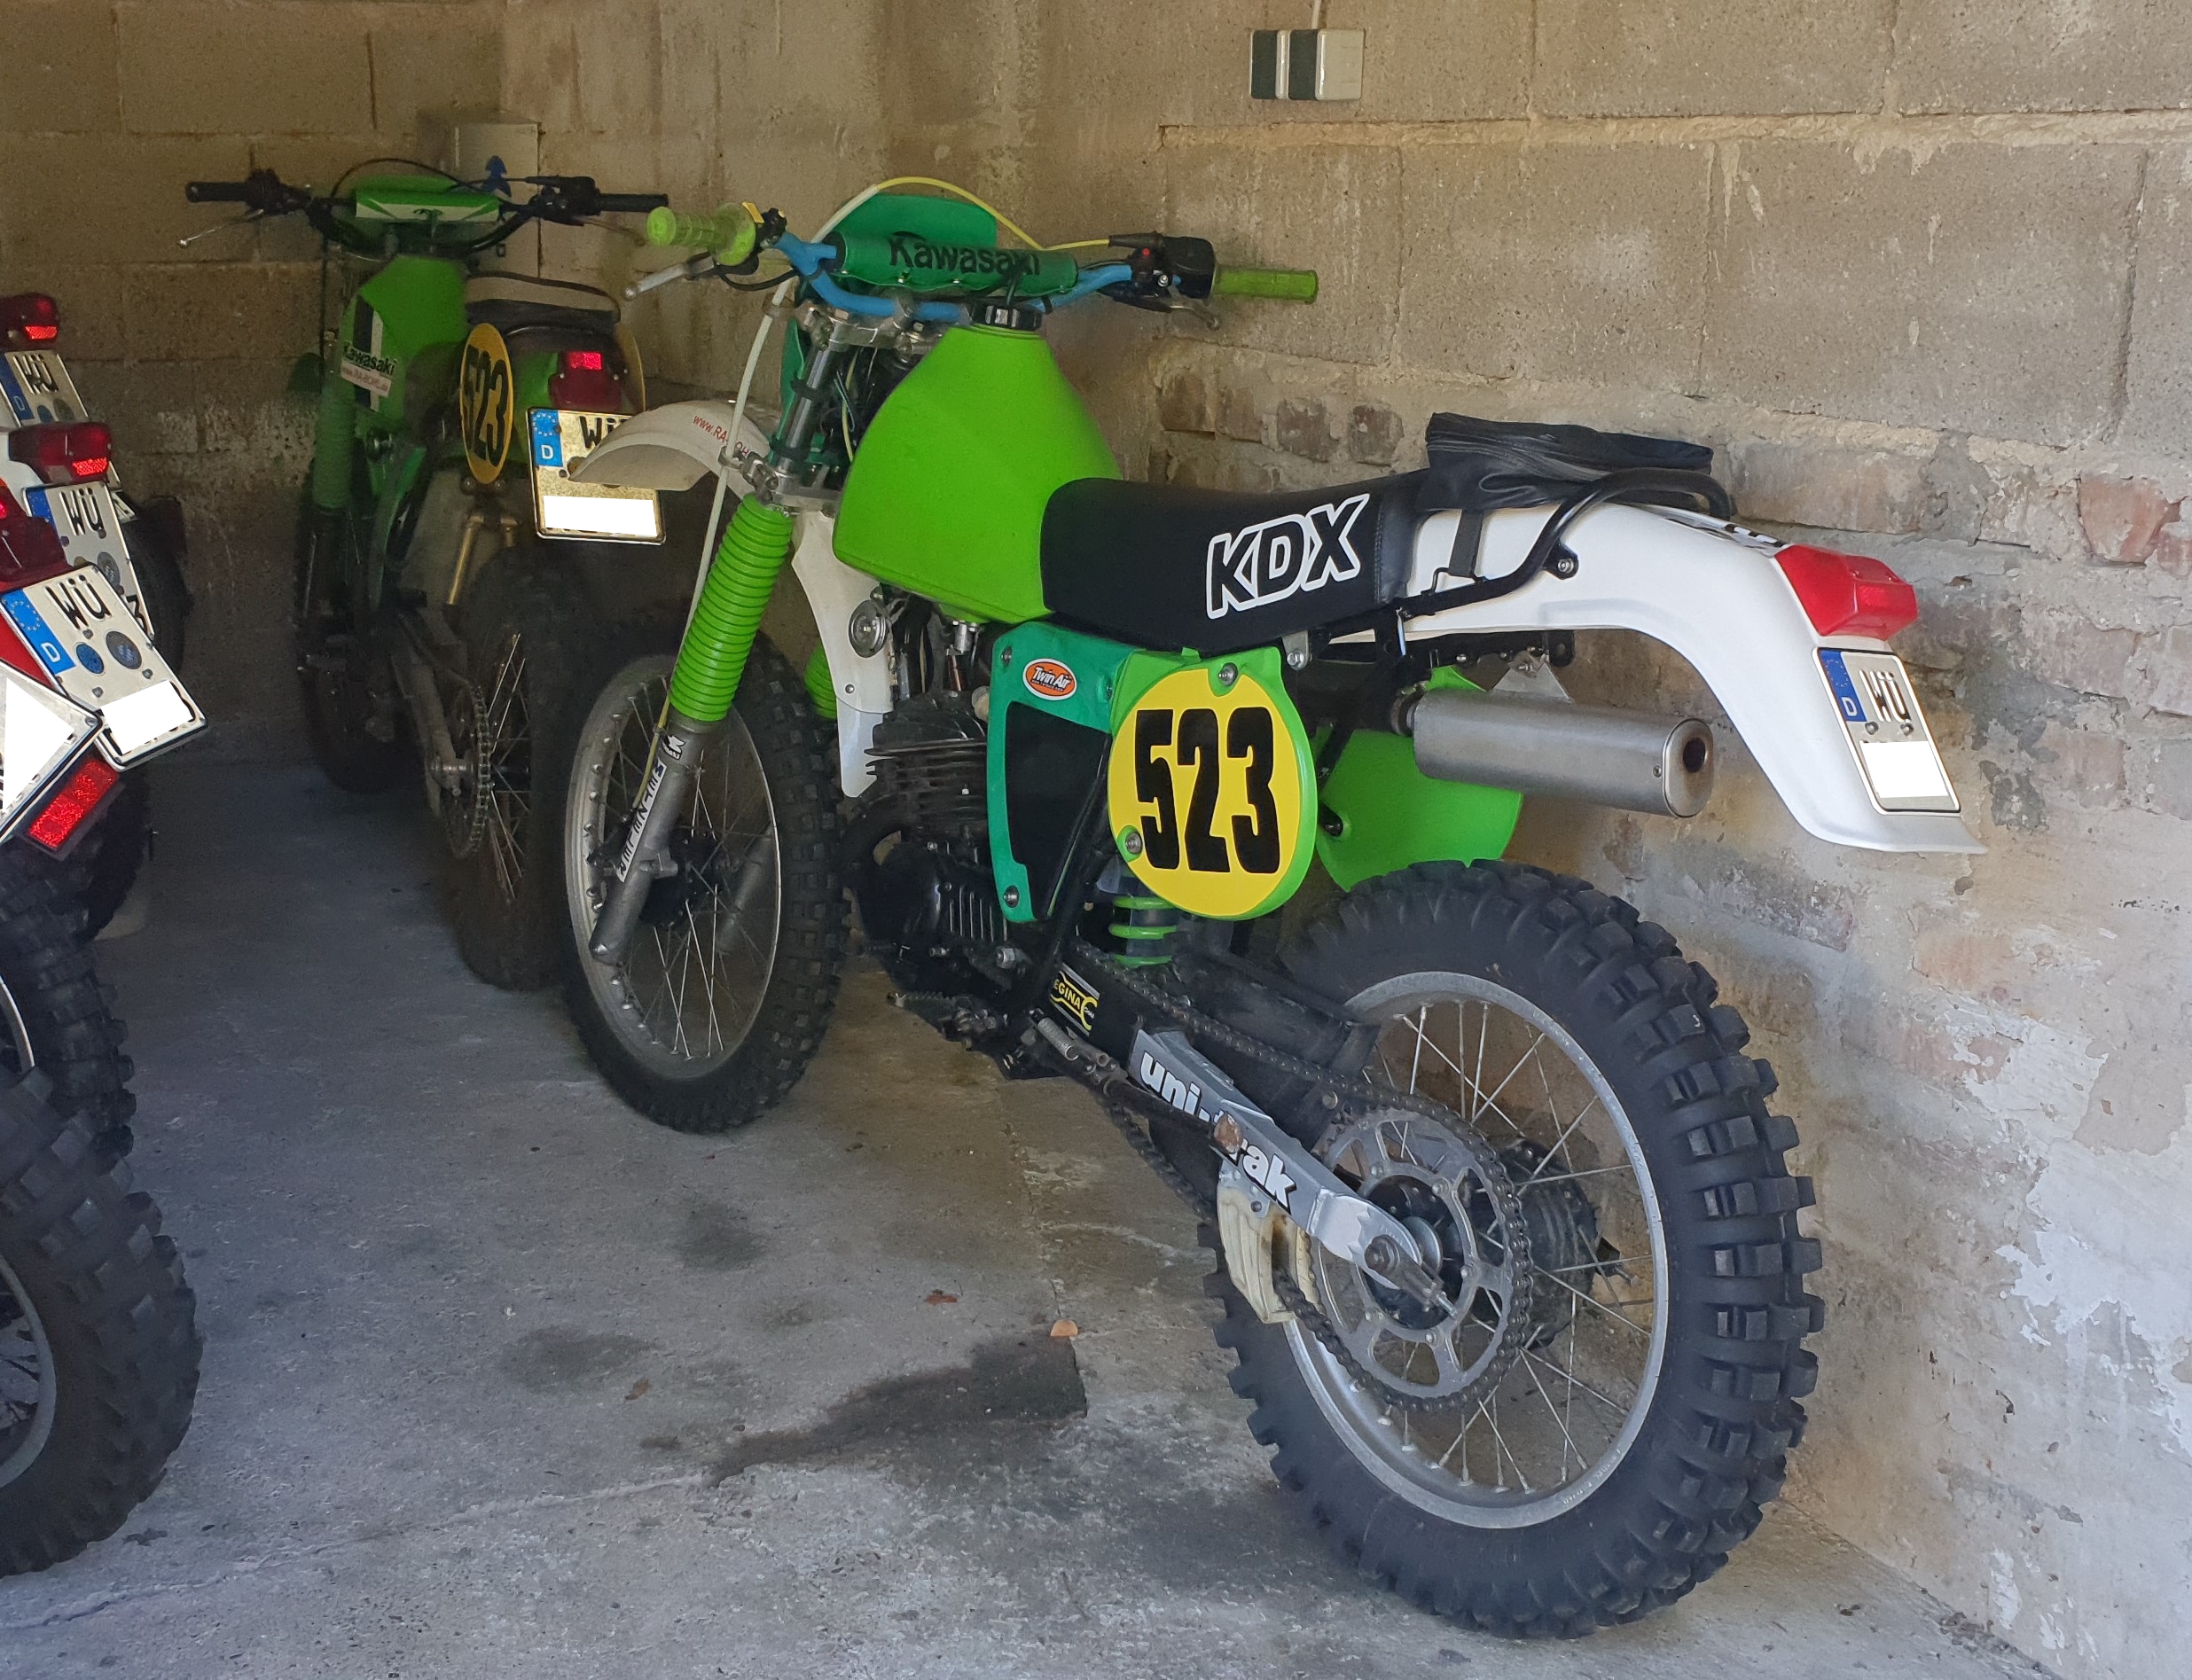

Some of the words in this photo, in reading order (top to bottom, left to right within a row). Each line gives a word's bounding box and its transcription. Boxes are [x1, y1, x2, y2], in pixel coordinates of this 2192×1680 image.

[12, 354, 59, 395] WÜ
[541, 444, 554, 459] D
[59, 487, 106, 535] WÜ
[1206, 493, 1370, 620] KDX
[44, 574, 113, 630] WÜ
[40, 642, 61, 663] D
[1032, 666, 1055, 685] Twin
[1053, 674, 1071, 690] Air
[1859, 669, 1912, 723] WÜ
[1841, 696, 1858, 716] D
[1134, 706, 1280, 874] 523
[1053, 978, 1081, 1011] EGINA
